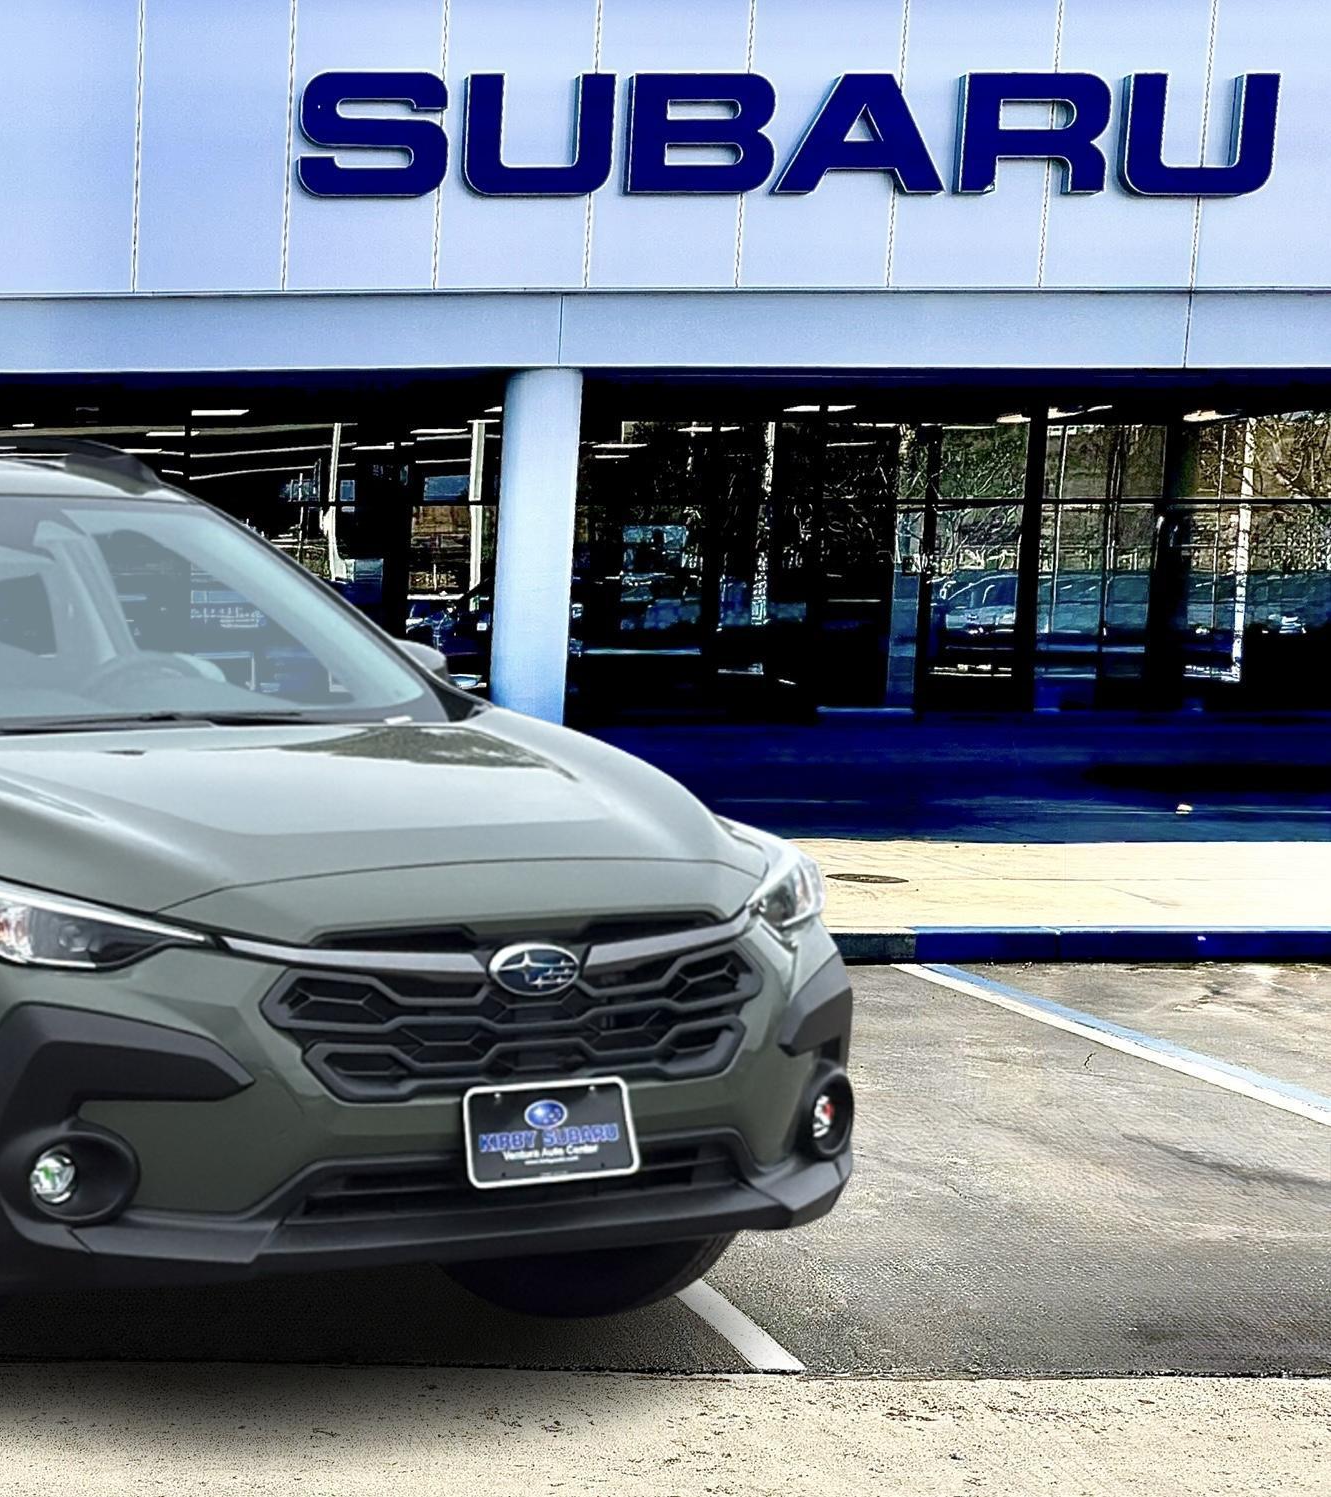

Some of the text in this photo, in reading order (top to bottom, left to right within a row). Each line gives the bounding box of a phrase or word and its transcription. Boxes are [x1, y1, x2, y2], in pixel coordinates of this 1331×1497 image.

[295, 70, 1283, 198] SUBARU
[479, 1124, 619, 1152] KIRBY SUBARU
[541, 1147, 564, 1158] Auto
[566, 1143, 599, 1155] Center
